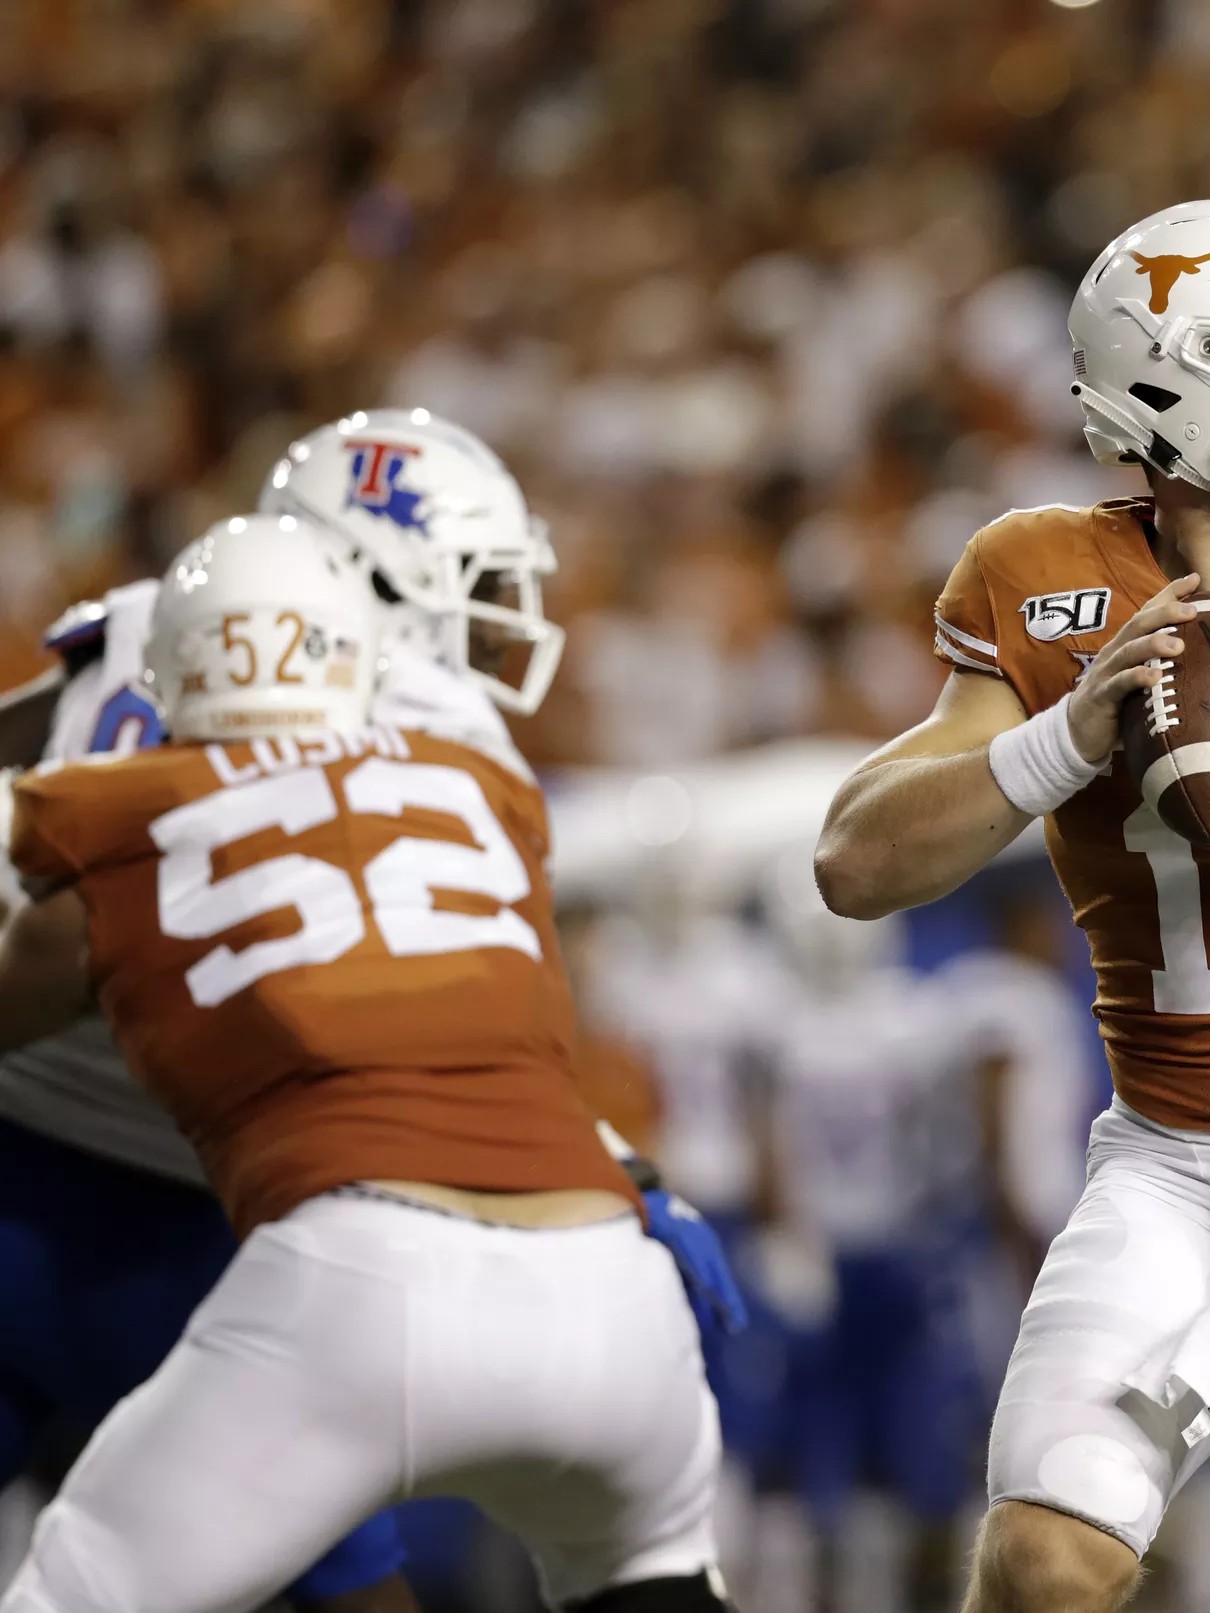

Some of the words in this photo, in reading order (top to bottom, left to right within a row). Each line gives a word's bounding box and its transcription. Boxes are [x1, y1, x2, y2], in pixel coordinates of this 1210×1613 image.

[222, 611, 305, 686] 52
[1025, 590, 1108, 638] 150
[148, 757, 541, 1008] 52
